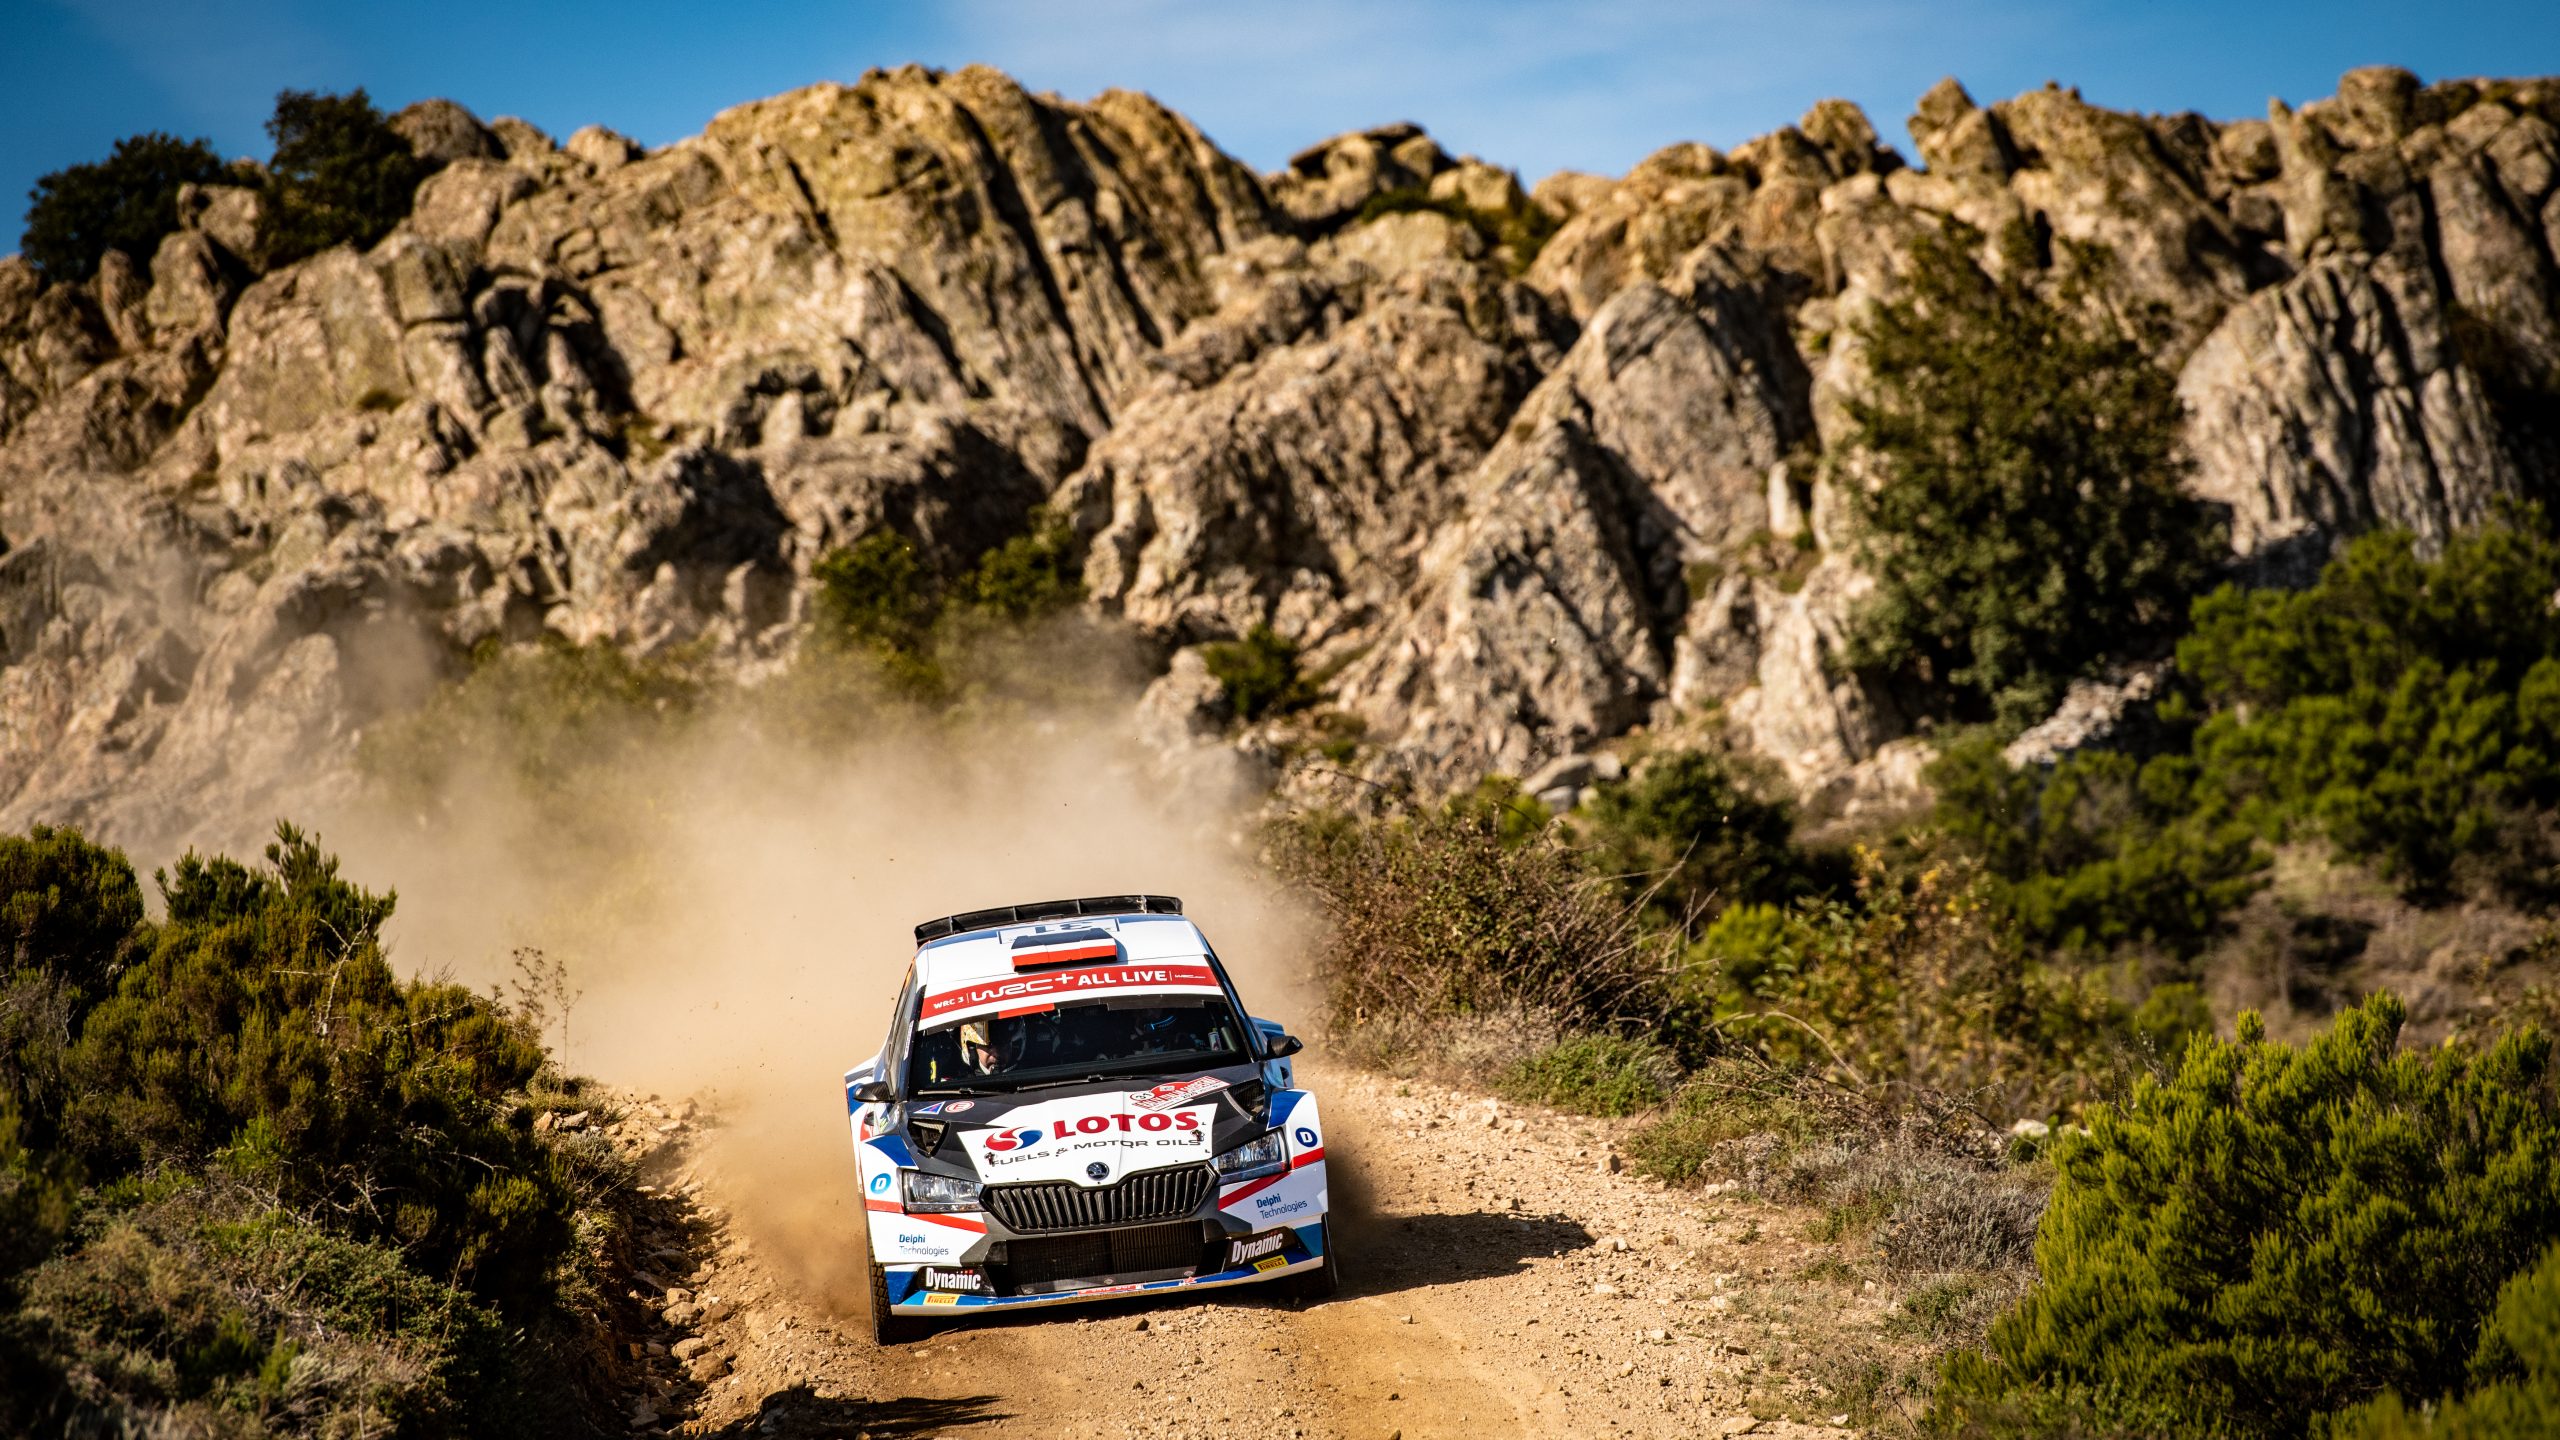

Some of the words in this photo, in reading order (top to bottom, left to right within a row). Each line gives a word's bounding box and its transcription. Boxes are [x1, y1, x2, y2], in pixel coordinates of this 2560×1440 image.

[933, 998, 955, 1009] WRC
[1078, 973, 1116, 985] ALL
[1122, 970, 1167, 982] LIVE
[1053, 1111, 1199, 1140] LOTOS
[1074, 1139, 1149, 1150] MOTOR
[1256, 1193, 1281, 1208] Delphi
[1260, 1200, 1307, 1219] Technologies
[899, 1234, 926, 1244] Delphi
[899, 1245, 949, 1256] Technologies
[1231, 1233, 1283, 1264] Dynamic
[1257, 1257, 1285, 1272] PIRELLI
[926, 1267, 981, 1290] Dynamic
[927, 1295, 956, 1304] PIRELLI
